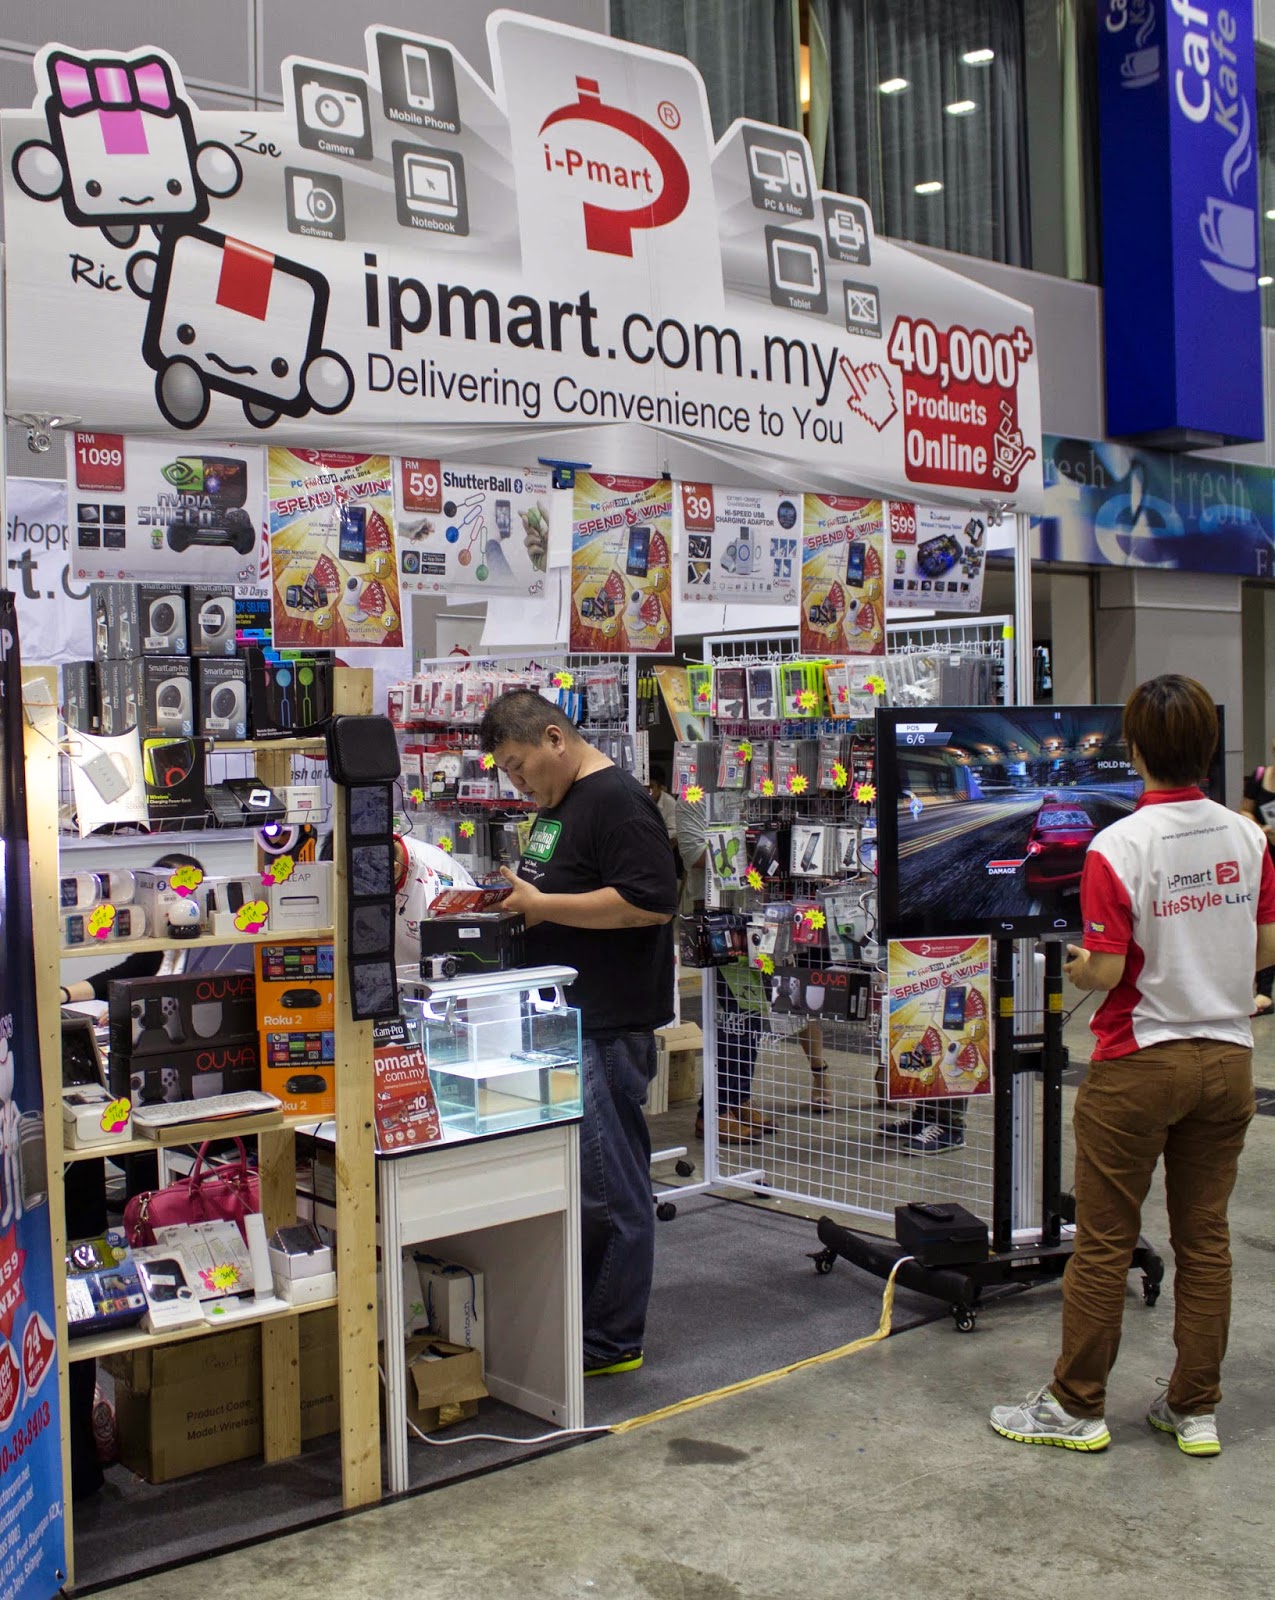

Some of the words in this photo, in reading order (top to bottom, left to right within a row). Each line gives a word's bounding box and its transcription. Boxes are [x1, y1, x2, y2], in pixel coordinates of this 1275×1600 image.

[1210, 9, 1239, 137] Kafe
[389, 107, 422, 127] Mobile
[424, 115, 456, 132] Phone
[233, 129, 282, 158] Zoe
[317, 138, 356, 157] Camera
[543, 142, 654, 194] i-Pmart
[764, 198, 778, 209] PC
[786, 204, 804, 217] Mac
[299, 224, 334, 239] Software
[411, 215, 456, 233] Notebook
[69, 253, 123, 292] Ric
[788, 296, 812, 311] Tablet
[363, 252, 839, 407] ipmart.com.my
[891, 320, 1032, 389] 40,000+
[367, 352, 541, 419] Delivering
[553, 375, 751, 434] Convenience
[759, 403, 785, 437] to
[792, 406, 844, 445] You
[906, 389, 988, 426] Products
[77, 434, 96, 444] RM
[78, 448, 122, 467] 1099
[907, 430, 988, 475] Online
[404, 460, 420, 470] RM
[1044, 450, 1106, 489] resh
[291, 480, 303, 488] PC
[340, 473, 357, 482] APRIL
[358, 470, 371, 478] 2014
[409, 472, 438, 497] 59
[442, 471, 512, 493] ShutterBall
[1168, 453, 1251, 525] Fresh
[275, 491, 332, 516] SPEND
[333, 483, 354, 506] &
[590, 503, 601, 511] PC
[616, 498, 629, 507] 2014
[686, 496, 712, 520] 39
[137, 506, 213, 526] SHIELD
[577, 514, 623, 537] SPEND
[624, 507, 640, 526] &
[715, 515, 746, 525] CHARGING
[747, 517, 775, 526] ADAPTOR
[724, 509, 752, 518] HI-SPEED
[818, 520, 827, 528] PC
[890, 515, 916, 534] 599
[807, 529, 844, 549] SPEND
[845, 524, 857, 541] &
[238, 586, 248, 596] 30
[249, 586, 269, 598] Days
[148, 664, 189, 673] SmartCam-Pro
[203, 667, 244, 676] SmartCam-Pro
[906, 733, 926, 746] 6/6
[311, 769, 322, 780] on
[1097, 761, 1119, 769] HOLD
[1119, 761, 1132, 769] the
[1161, 824, 1229, 841] www.ipmart-lifestyle.com
[1167, 868, 1212, 889] i-Pmart
[1152, 891, 1223, 918] LifeStyle
[907, 969, 917, 978] PC
[931, 962, 945, 973] 2014
[946, 961, 960, 969] APRIL
[196, 977, 256, 1000] OUYA
[811, 971, 847, 987] OUYA
[894, 976, 939, 1000] SPEND
[940, 970, 956, 987] &
[264, 1015, 293, 1026] Roku
[295, 1014, 303, 1025] 2
[196, 1047, 256, 1071] OUYA
[374, 1049, 426, 1077] pmart
[383, 1067, 425, 1083] .com.my
[281, 1100, 298, 1111] oku
[300, 1100, 307, 1110] 2
[413, 1095, 427, 1110] 10
[0, 1275, 21, 1319] NLY
[26, 1321, 41, 1368] 24
[28, 1356, 44, 1385] Hours
[186, 1404, 225, 1422] Product
[226, 1399, 250, 1412] Code
[300, 1393, 335, 1410] Camera
